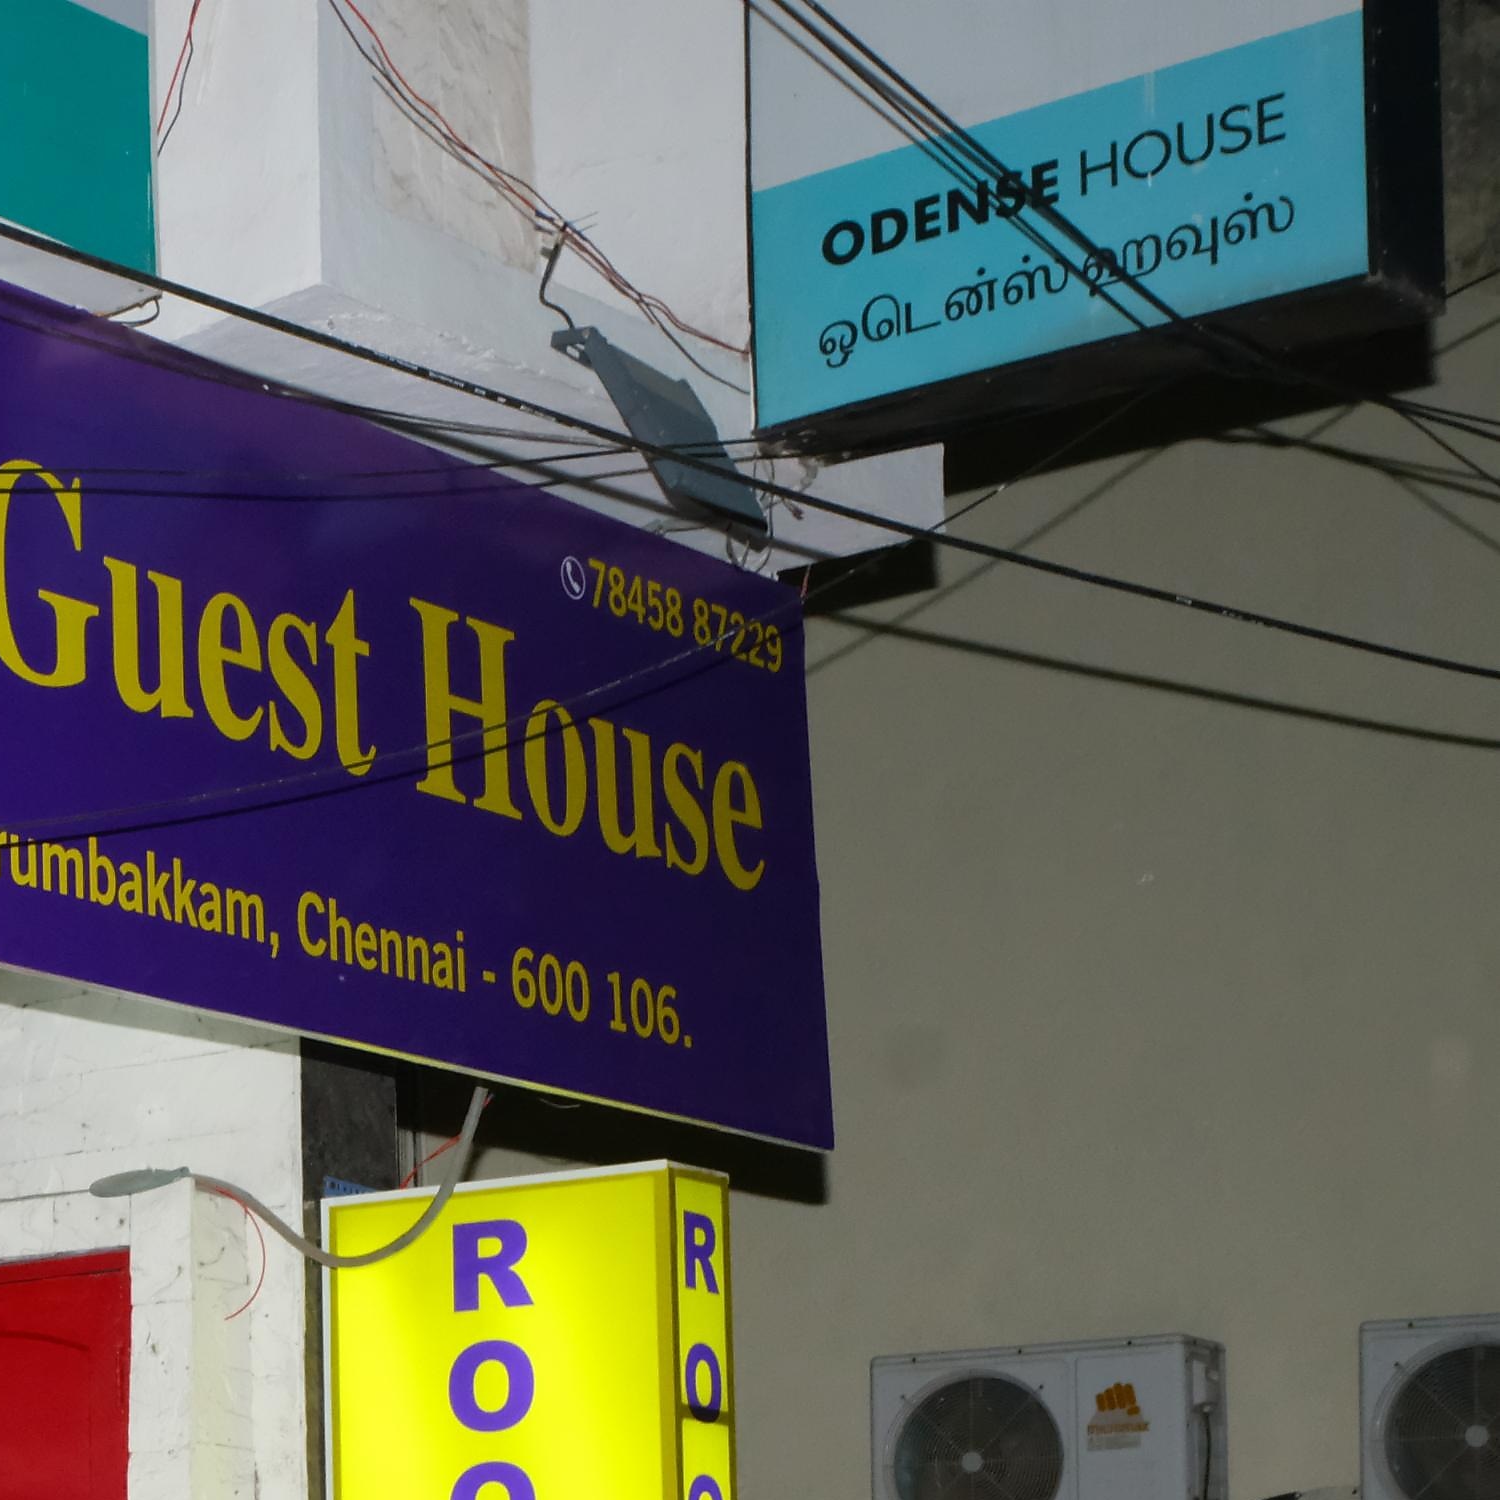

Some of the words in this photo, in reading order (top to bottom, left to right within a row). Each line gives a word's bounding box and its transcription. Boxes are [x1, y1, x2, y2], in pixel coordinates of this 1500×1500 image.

[821, 159, 1060, 265] ODENSE
[1080, 93, 1287, 197] HOUSE
[588, 558, 684, 637] 78458
[692, 597, 783, 673] 87229
[409, 597, 767, 892] House
[297, 890, 466, 993] Chennai
[511, 946, 589, 1023] 600
[606, 971, 693, 1049] 106.
